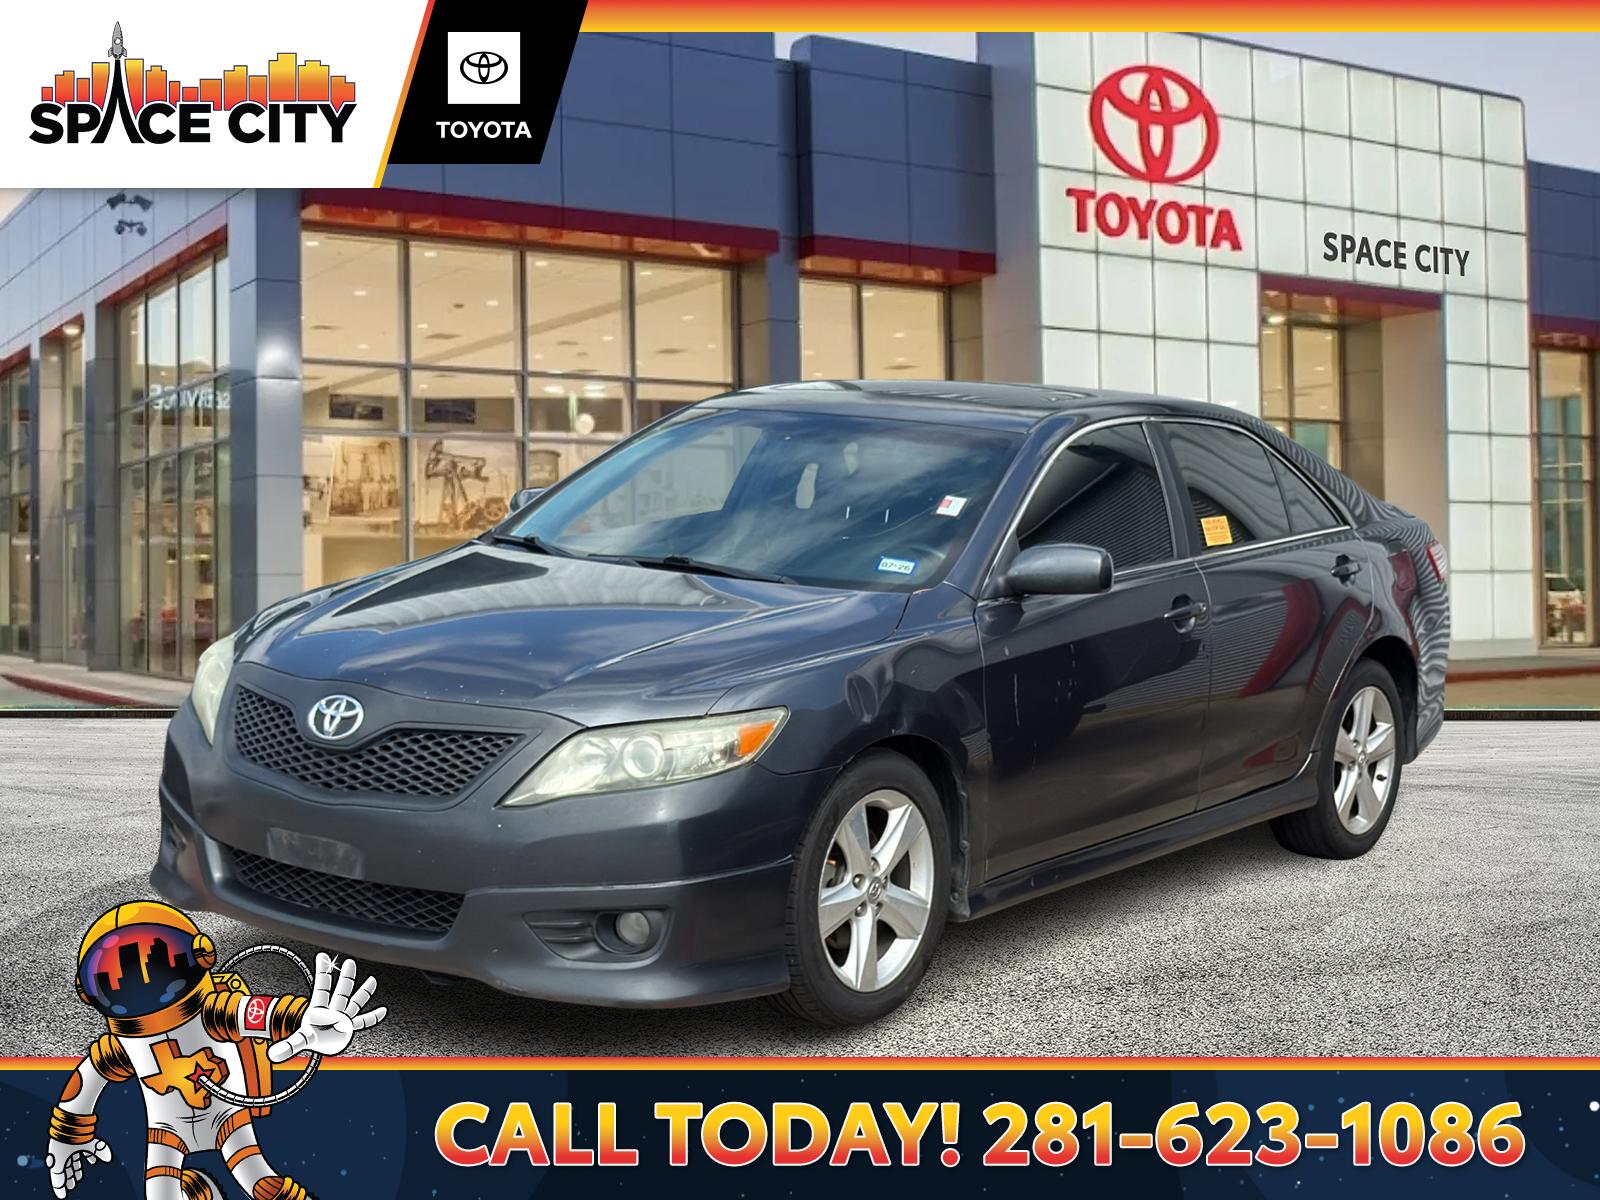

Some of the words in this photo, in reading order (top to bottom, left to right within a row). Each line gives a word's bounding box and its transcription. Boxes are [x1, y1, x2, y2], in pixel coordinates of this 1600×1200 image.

[1066, 188, 1243, 251] TOYOTA
[1322, 232, 1407, 270] SPACE
[1415, 245, 1470, 277] CITY
